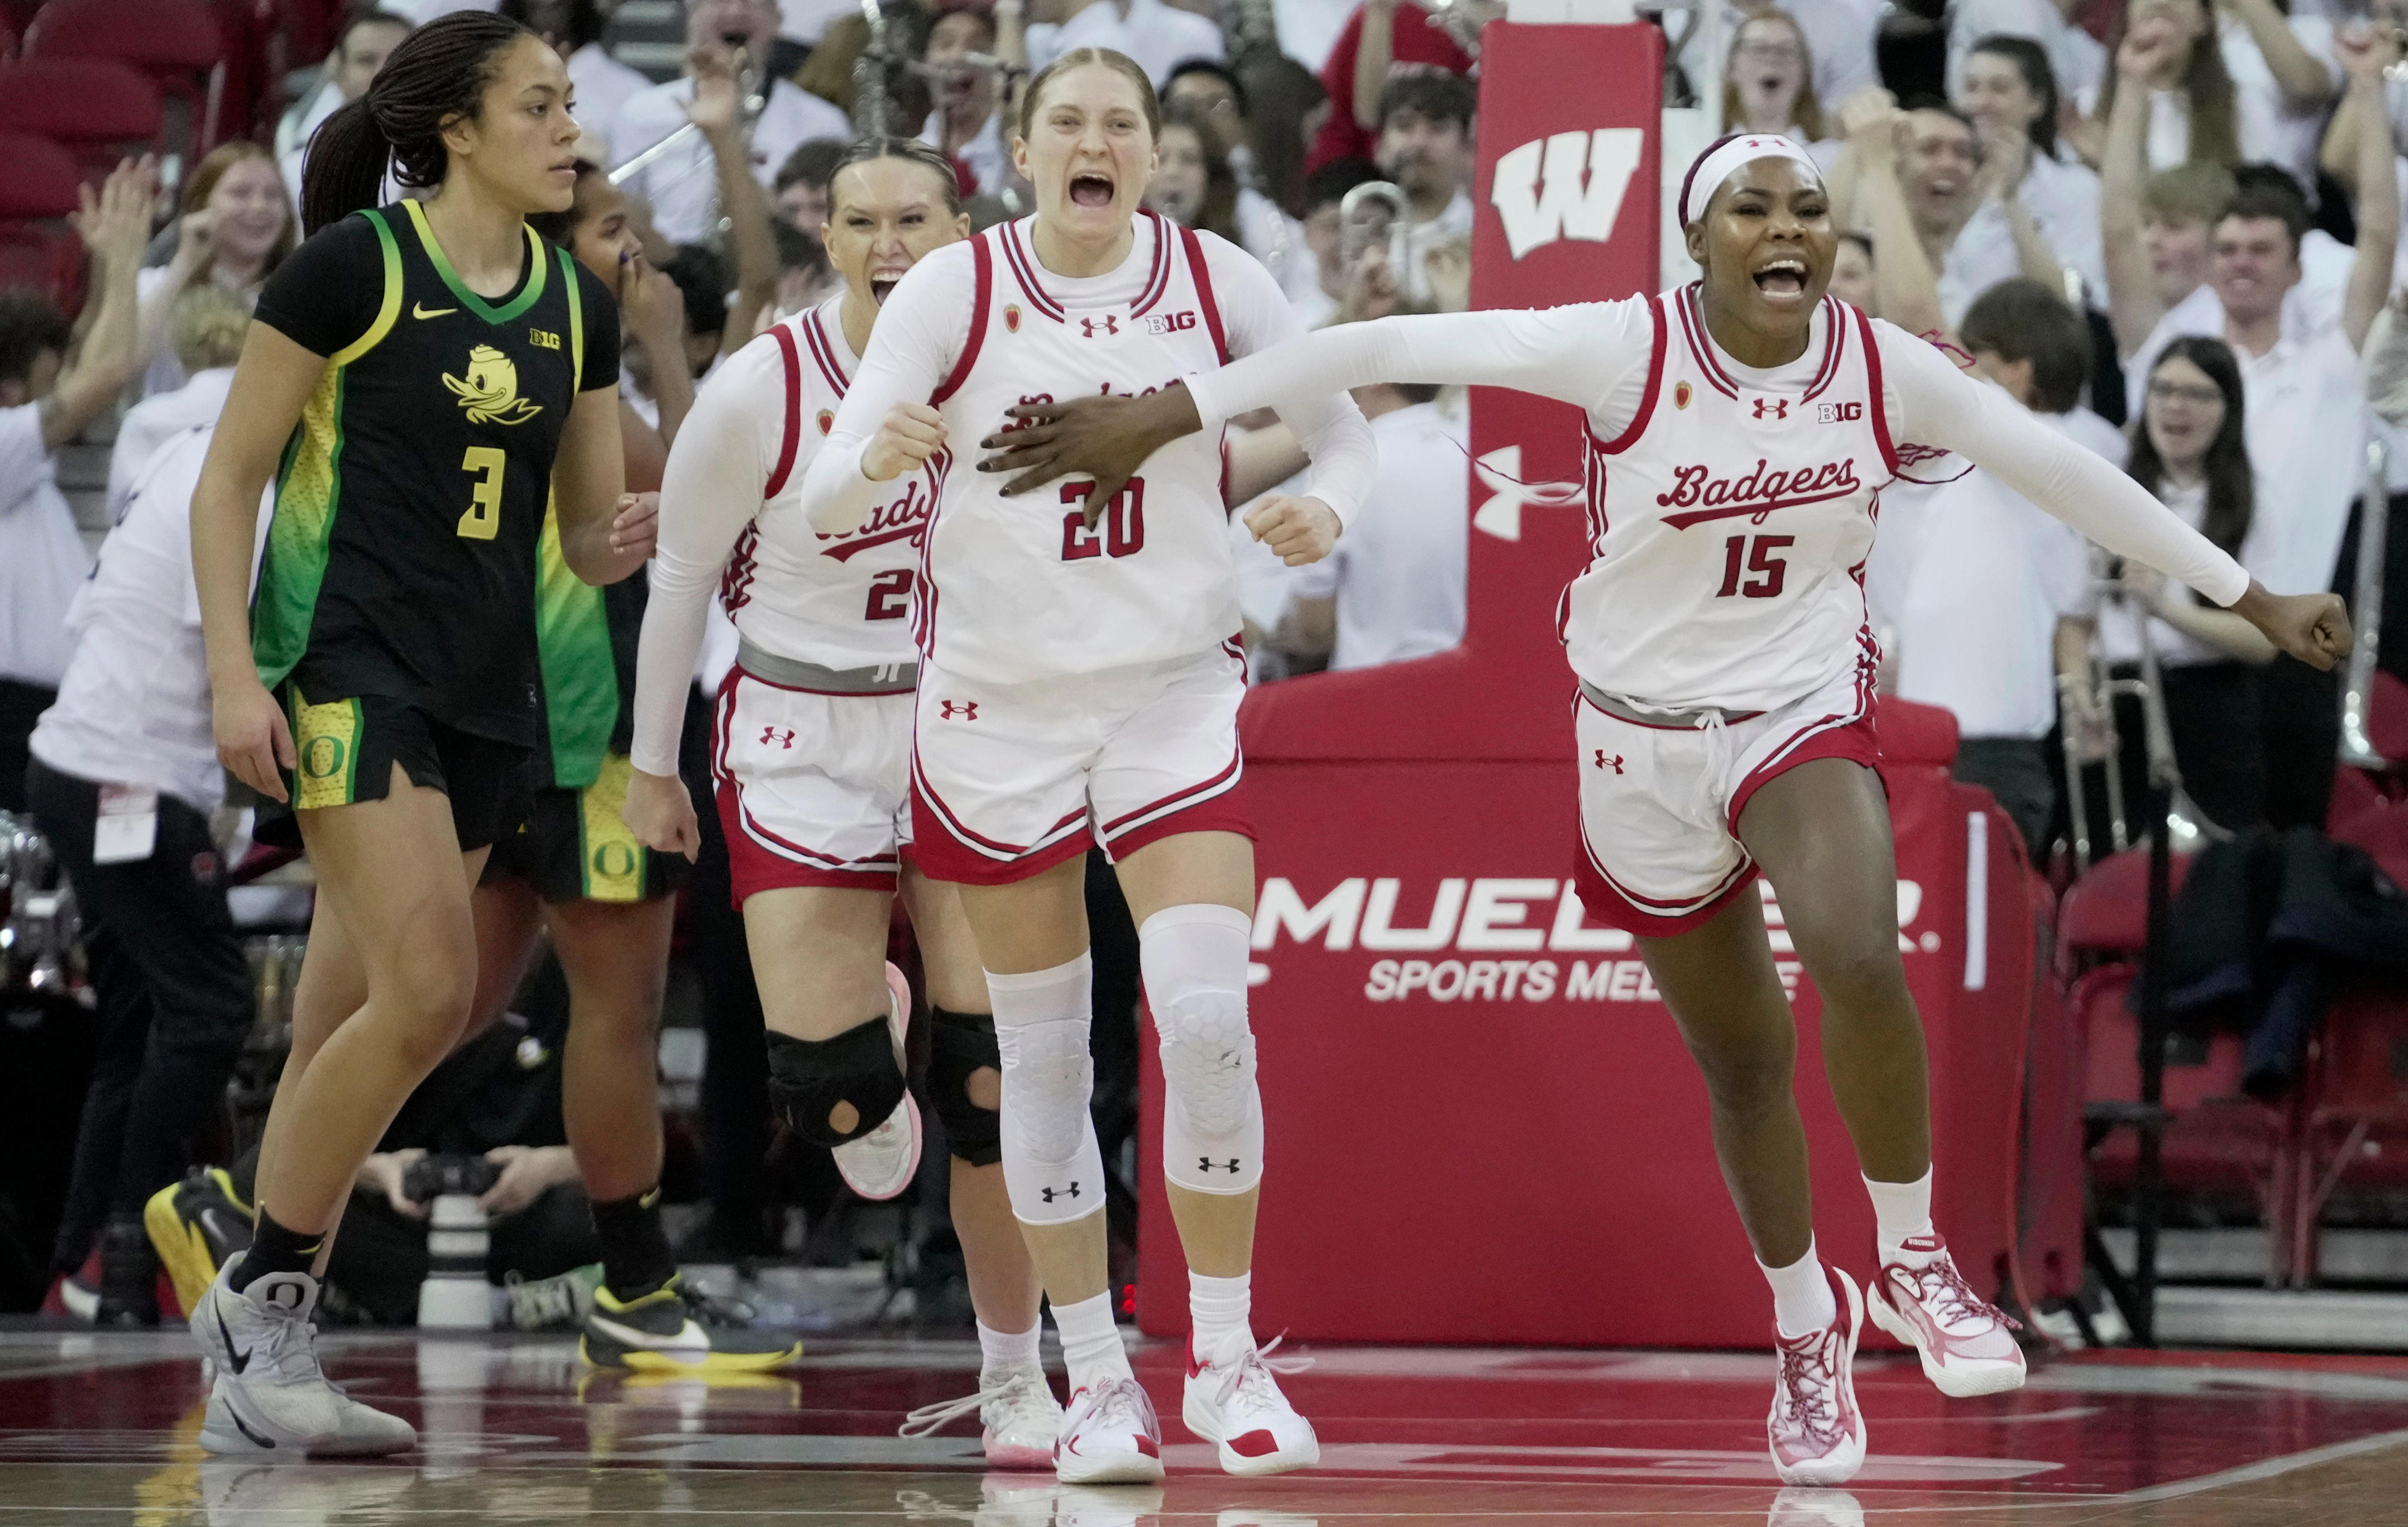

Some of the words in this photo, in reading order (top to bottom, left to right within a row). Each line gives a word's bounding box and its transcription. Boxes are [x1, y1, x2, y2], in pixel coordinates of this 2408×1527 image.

[1490, 127, 1643, 261] W
[457, 446, 505, 540] 3
[1059, 476, 1145, 561] 20
[1657, 458, 1860, 525] Badgers
[1715, 534, 1796, 598] 15
[301, 735, 345, 779] O
[1365, 959, 1558, 1002] SPORTS
